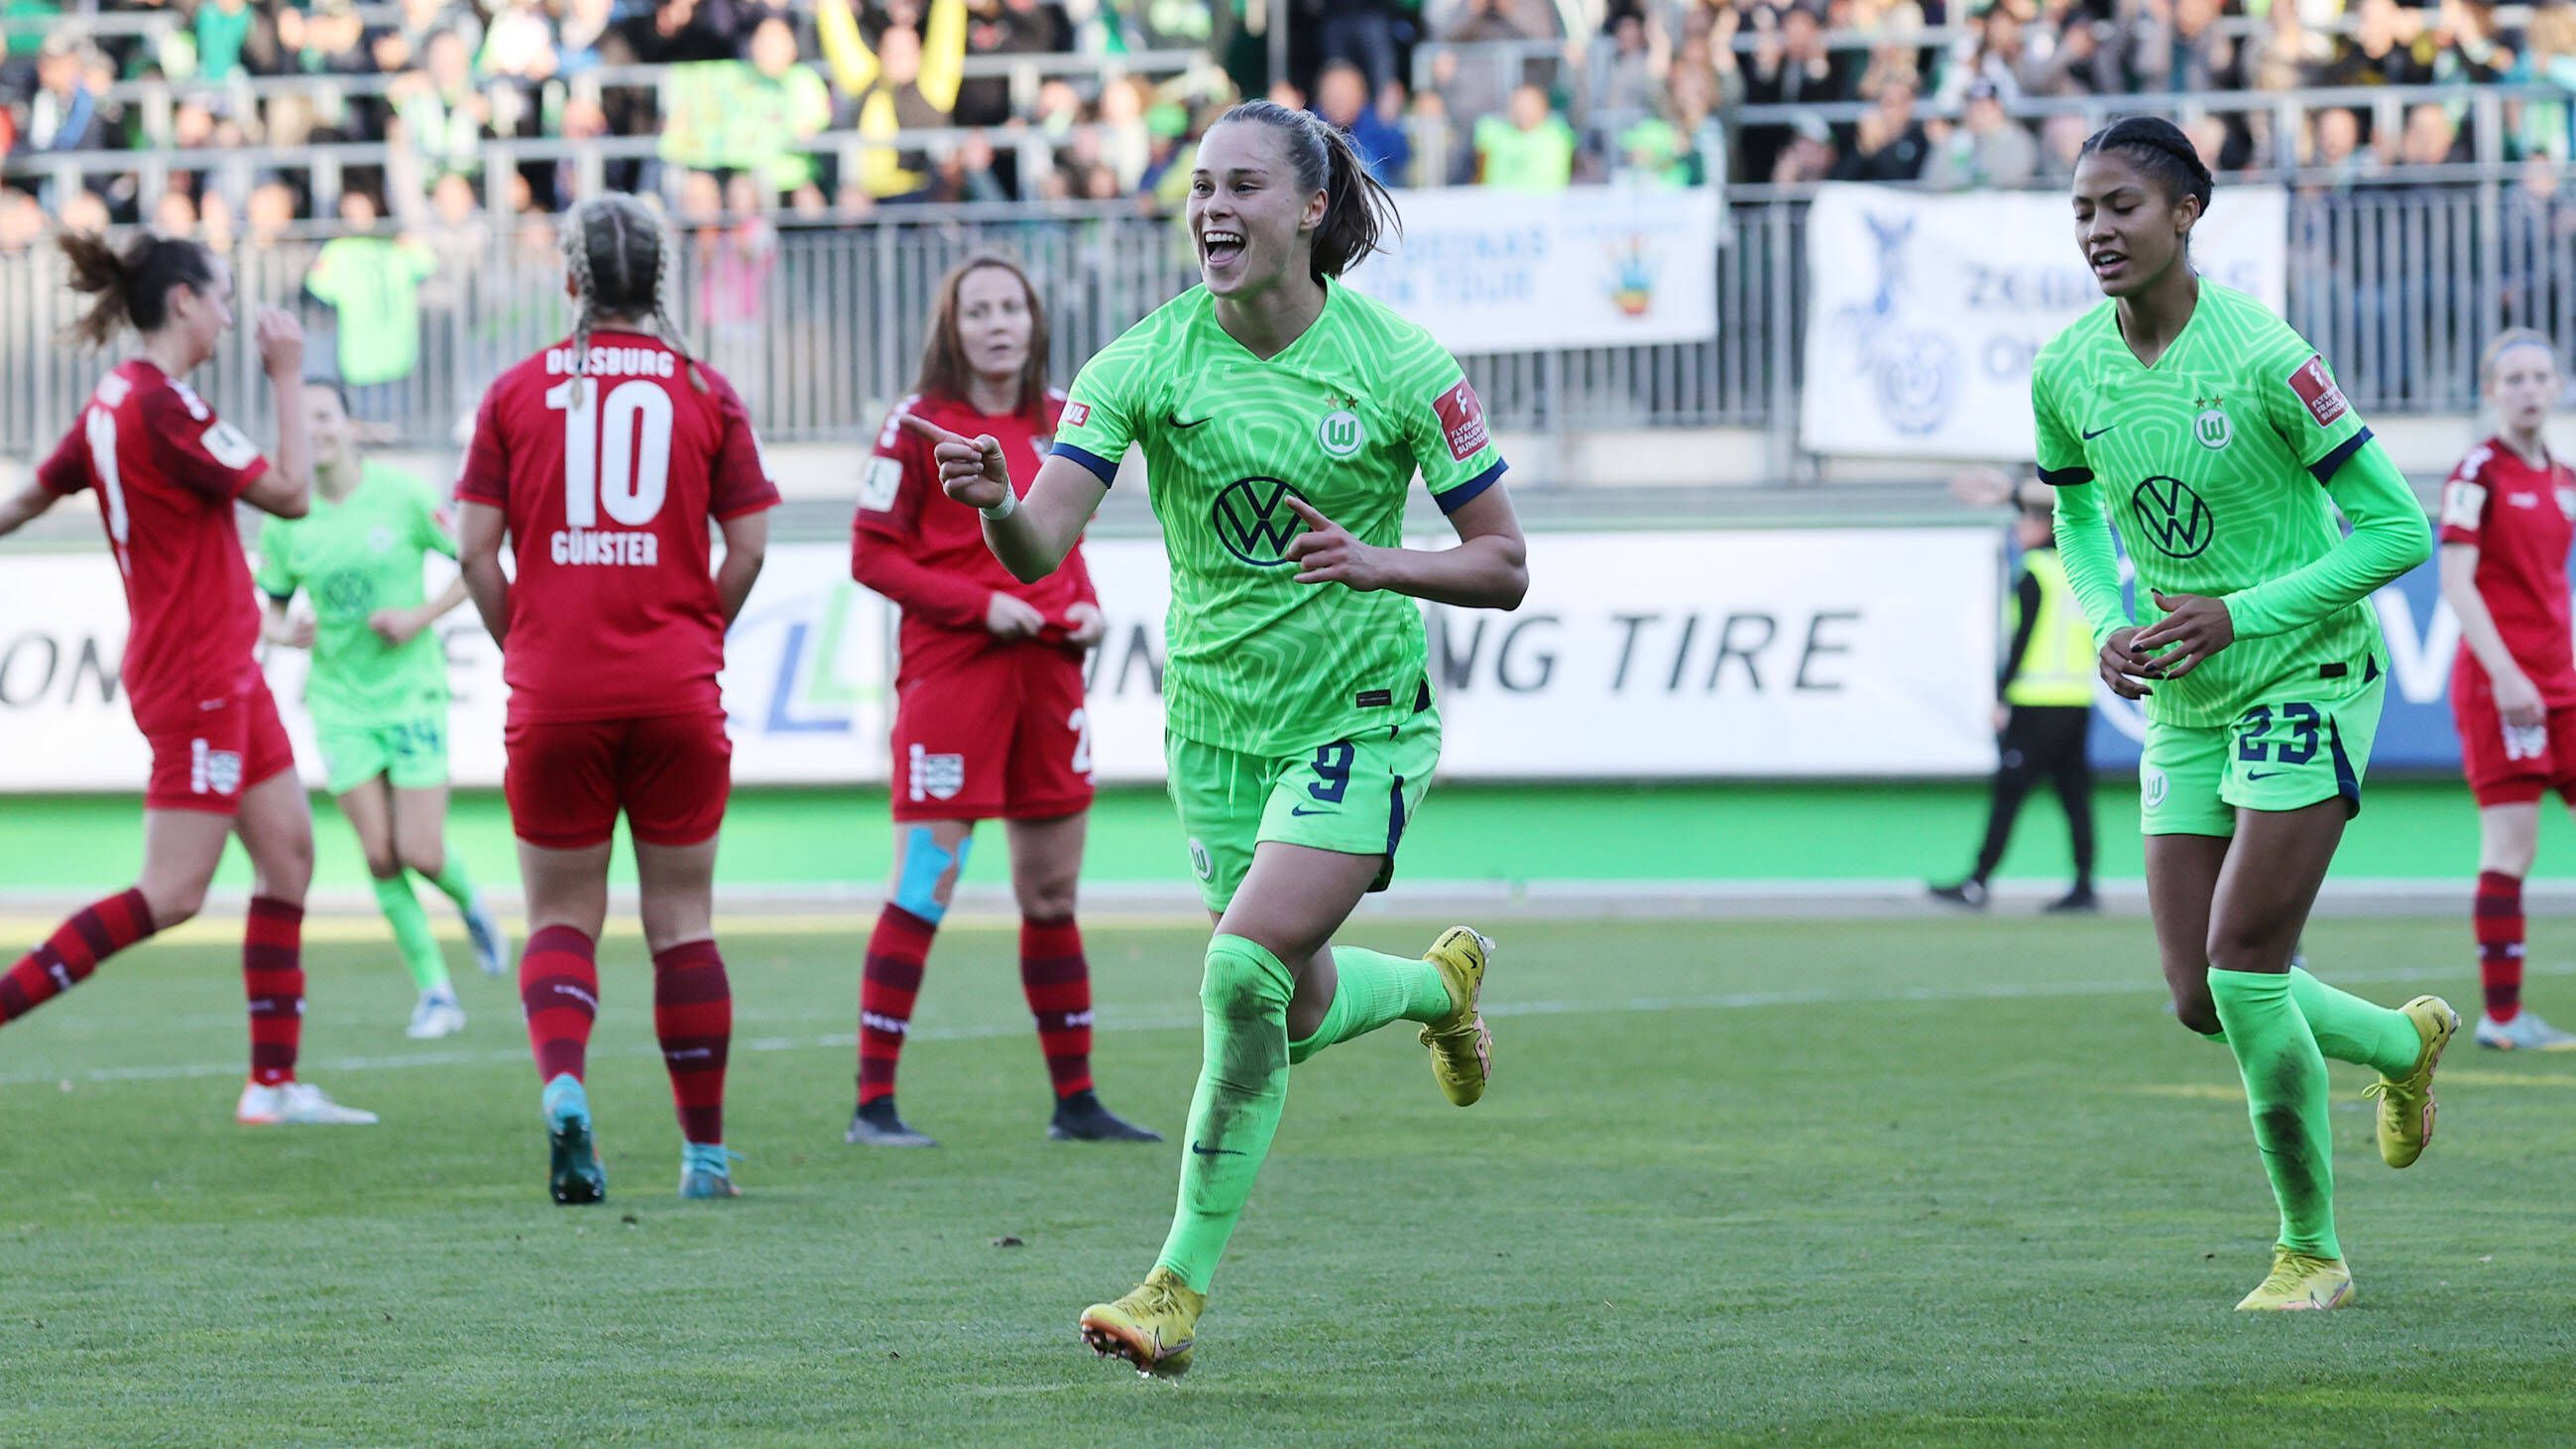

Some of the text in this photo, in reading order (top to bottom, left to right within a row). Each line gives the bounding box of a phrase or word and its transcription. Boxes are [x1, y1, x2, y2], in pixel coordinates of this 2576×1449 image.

[545, 377, 674, 527] 10
[550, 528, 658, 566] GÜNSTER
[2133, 478, 2206, 552] VW
[1610, 611, 1862, 692] TIRE
[2239, 702, 2321, 765] 23
[1308, 739, 1355, 804] 9
